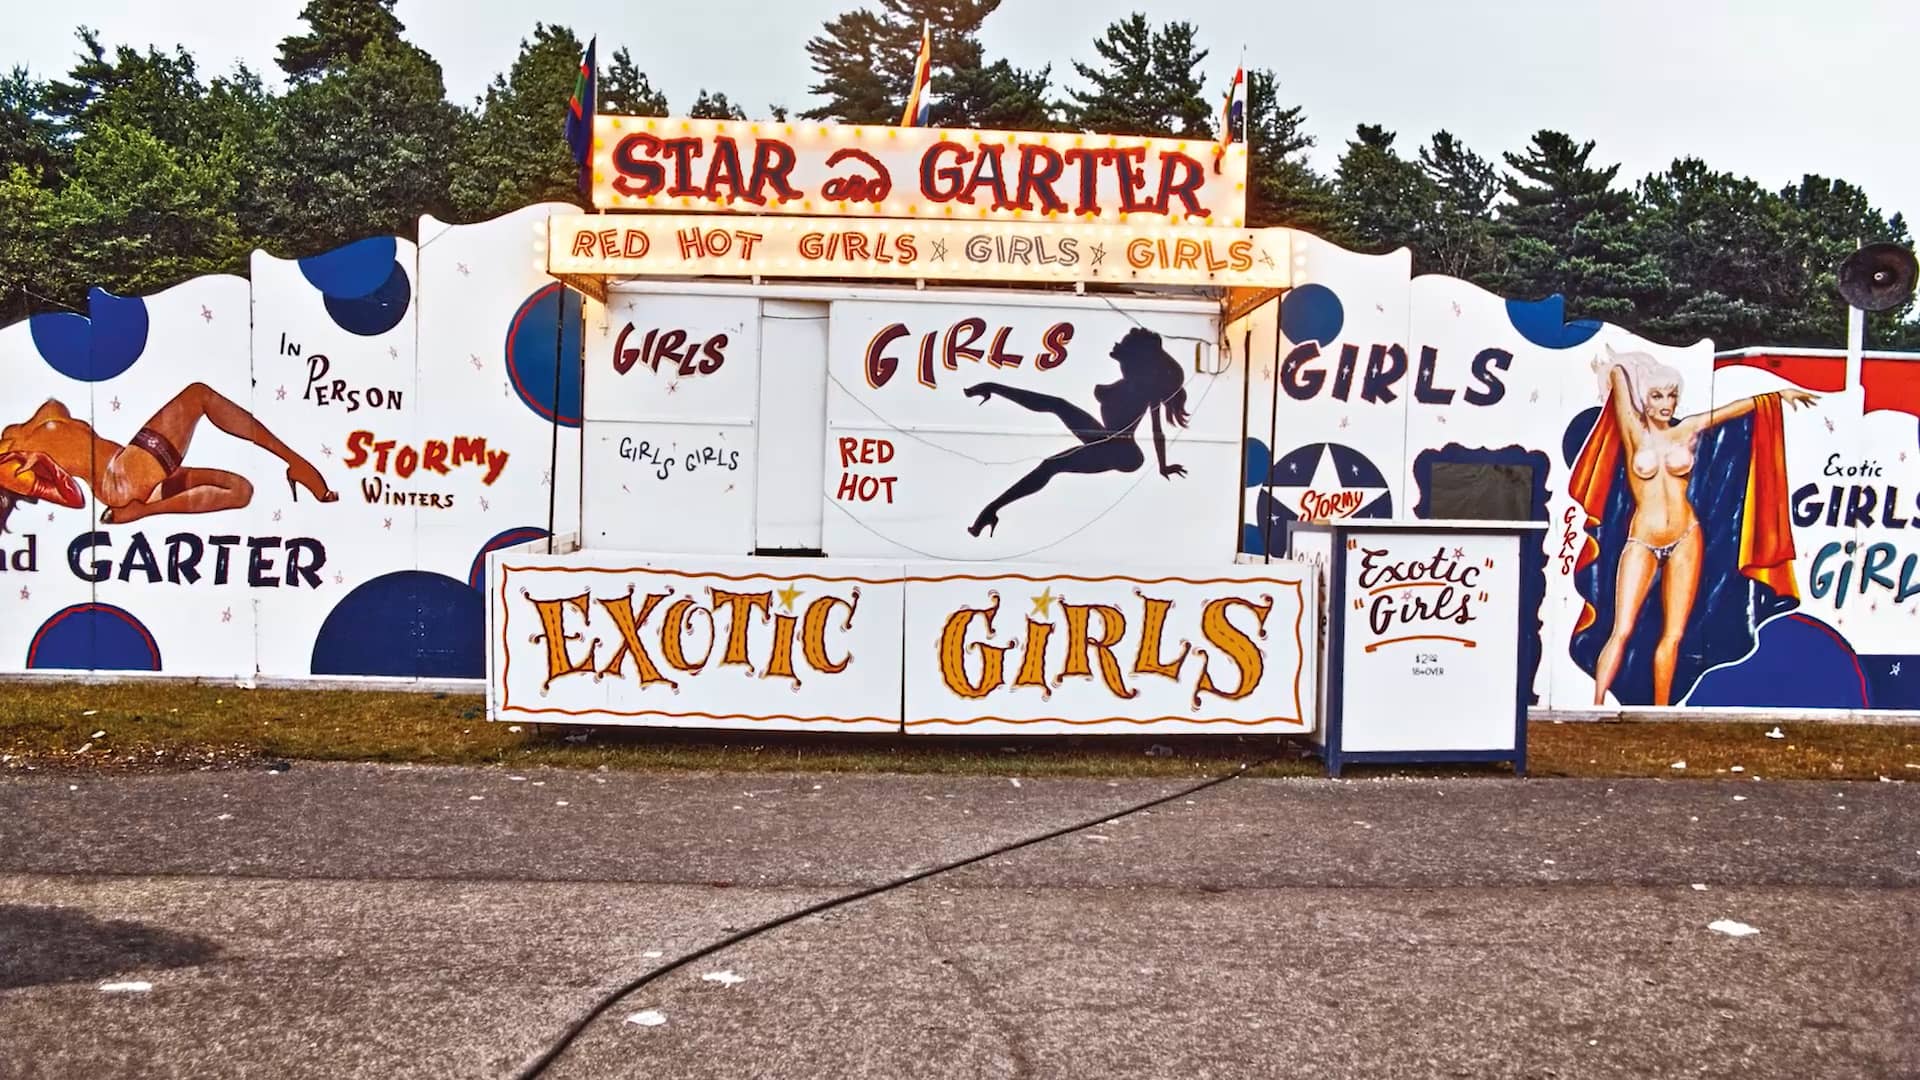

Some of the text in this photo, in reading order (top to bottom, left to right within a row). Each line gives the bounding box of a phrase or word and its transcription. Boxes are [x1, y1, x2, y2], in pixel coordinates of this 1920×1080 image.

[612, 132, 1213, 219] STAR and GARTER
[572, 226, 1255, 272] RED HOT GIRLS GIRLS GIRLS
[612, 321, 729, 377] GIRLS
[864, 317, 1075, 390] GIRLS
[1280, 343, 1514, 406] GIRLS
[619, 436, 740, 480] GIRLS GIRLS
[838, 437, 894, 468] RED
[1823, 453, 1883, 477] Exotic
[836, 472, 898, 504] HOT
[1298, 489, 1364, 522] STORMY
[66, 530, 327, 590] GARTER
[1558, 506, 1578, 575] GIRLS
